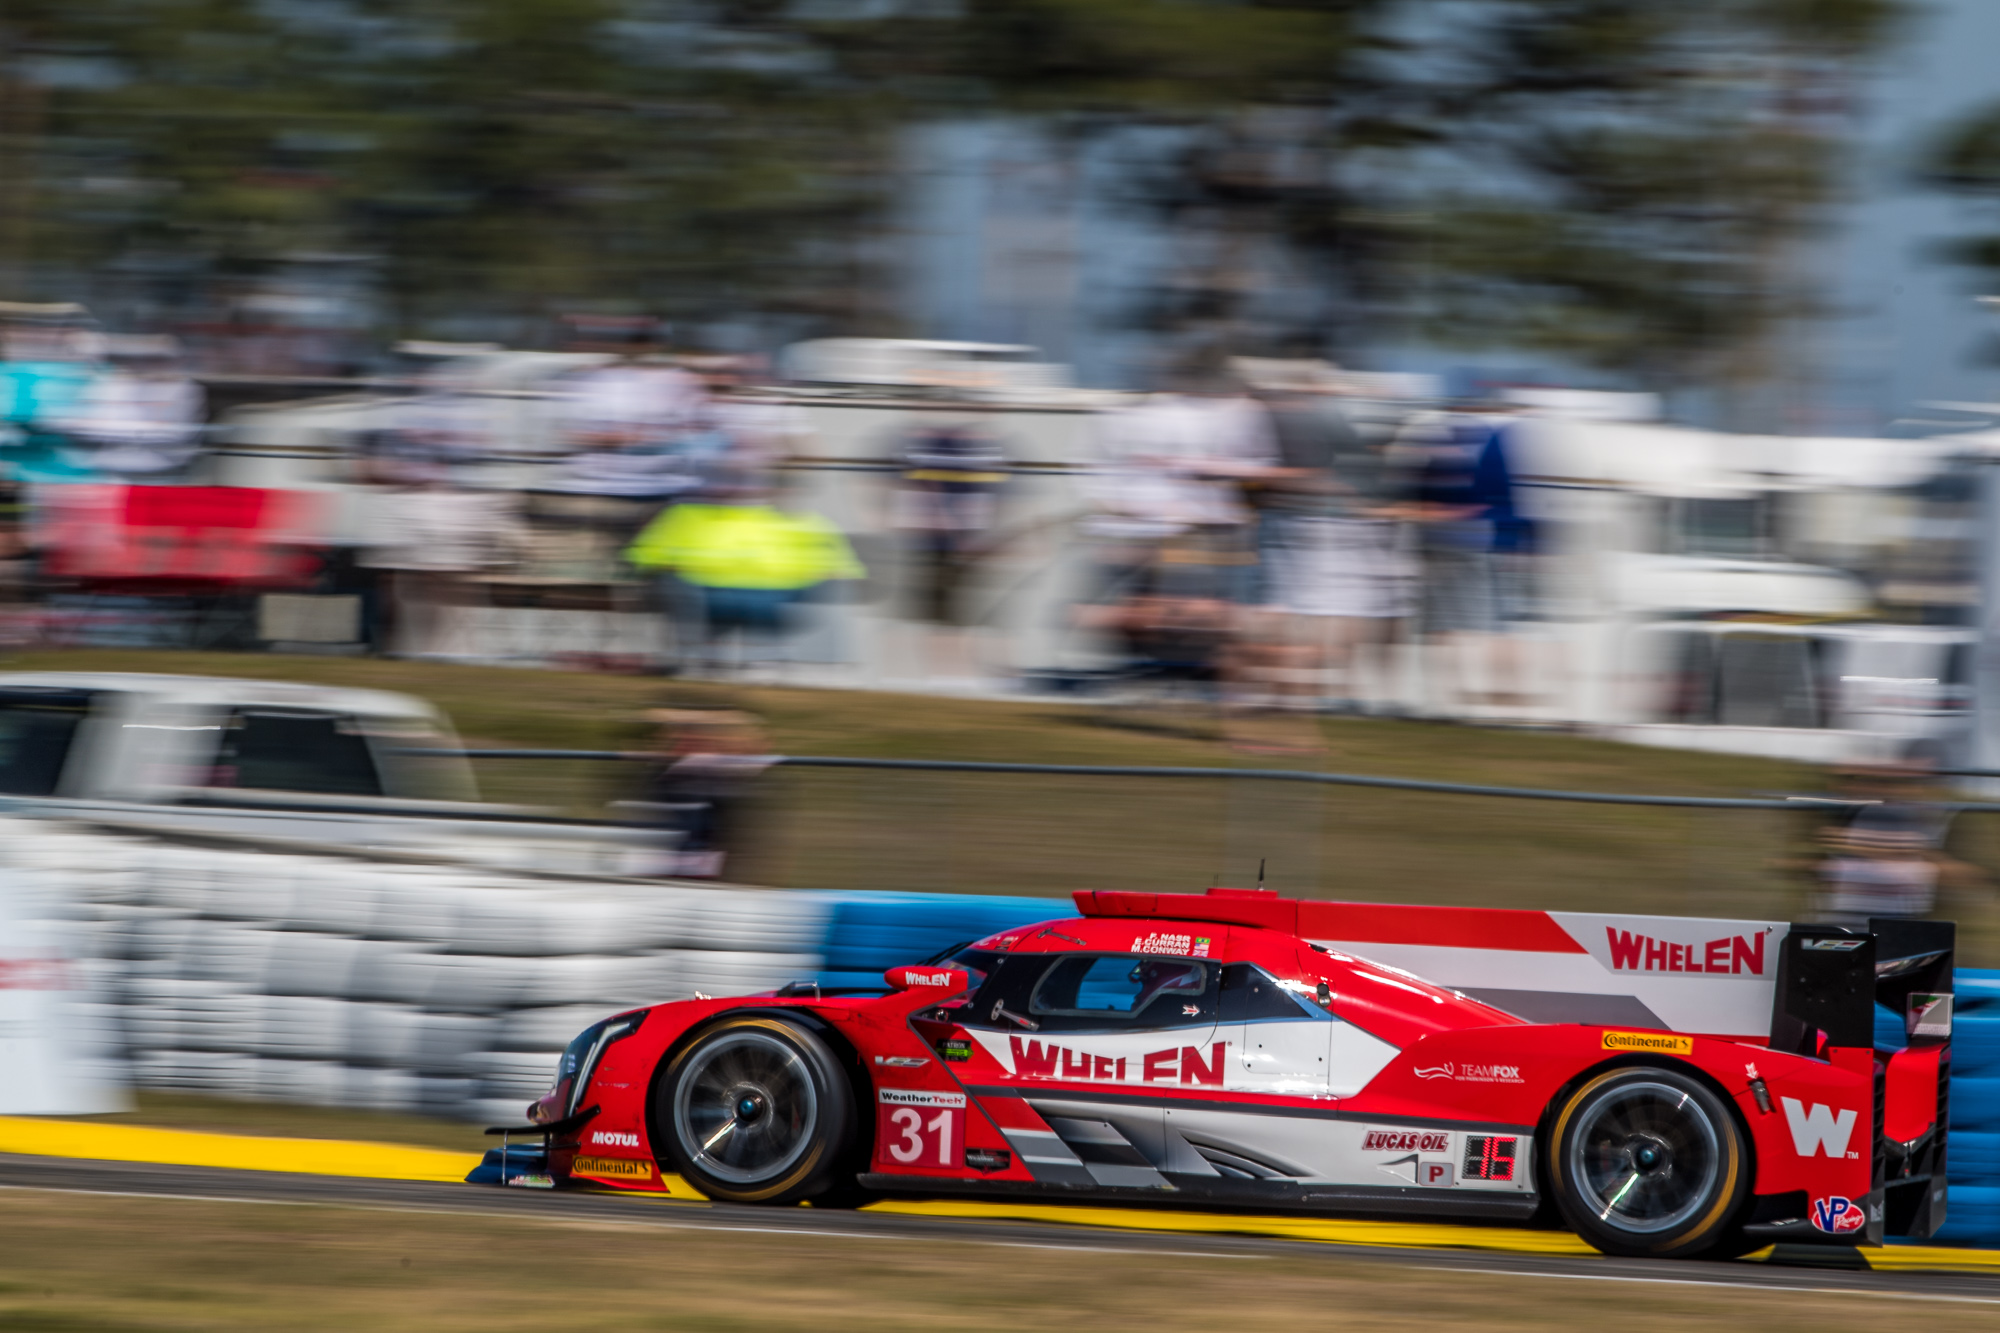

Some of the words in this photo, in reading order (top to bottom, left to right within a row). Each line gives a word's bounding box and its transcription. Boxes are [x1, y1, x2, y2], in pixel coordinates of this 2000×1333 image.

[1160, 933, 1191, 942] NASR
[1130, 944, 1190, 956] M.CONWAY
[1605, 925, 1765, 975] WHELEN
[905, 971, 950, 987] WHELEN
[1603, 1033, 1678, 1049] Continental
[881, 1091, 963, 1105] WeatherTech
[889, 1107, 953, 1165] 31
[1780, 1096, 1858, 1158] W
[592, 1130, 639, 1147] MOTUL
[1364, 1132, 1418, 1150] LUCAS
[1420, 1134, 1449, 1151] OIL
[573, 1156, 638, 1175] Continental
[1428, 1165, 1445, 1183] P
[1814, 1195, 1851, 1233] VP
